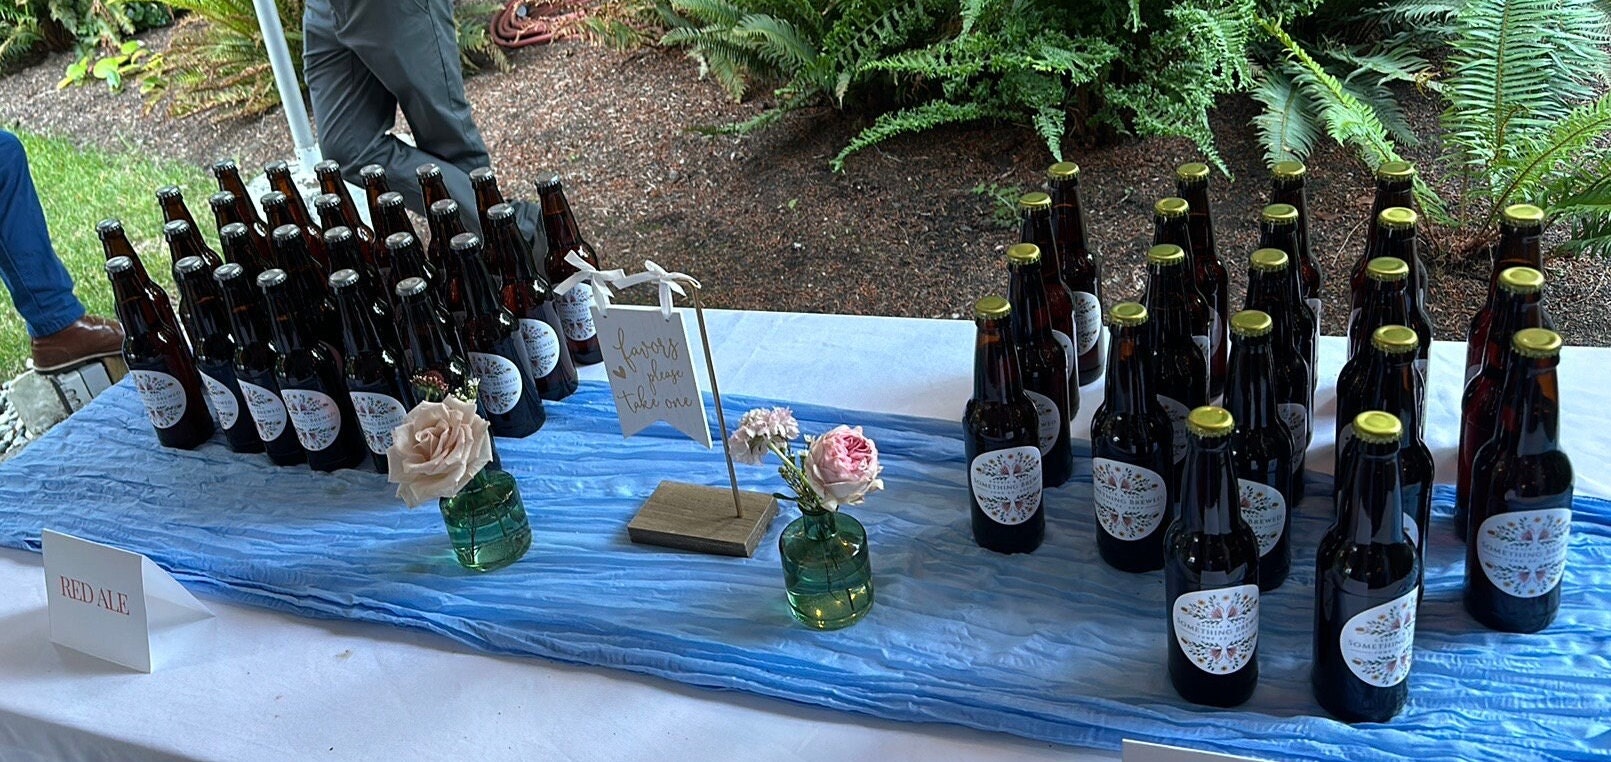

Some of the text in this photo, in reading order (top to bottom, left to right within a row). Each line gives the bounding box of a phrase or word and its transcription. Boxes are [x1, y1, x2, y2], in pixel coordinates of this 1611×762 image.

[612, 327, 679, 372] favors
[646, 359, 683, 396] please
[616, 385, 693, 414] take one
[973, 476, 1019, 491] SOMETHING
[1129, 495, 1164, 506] BREWED
[1248, 513, 1283, 525] BREWED
[1481, 541, 1542, 558] SOMETHING
[60, 575, 130, 615] RED ALE
[1177, 616, 1234, 637] SOMETHING
